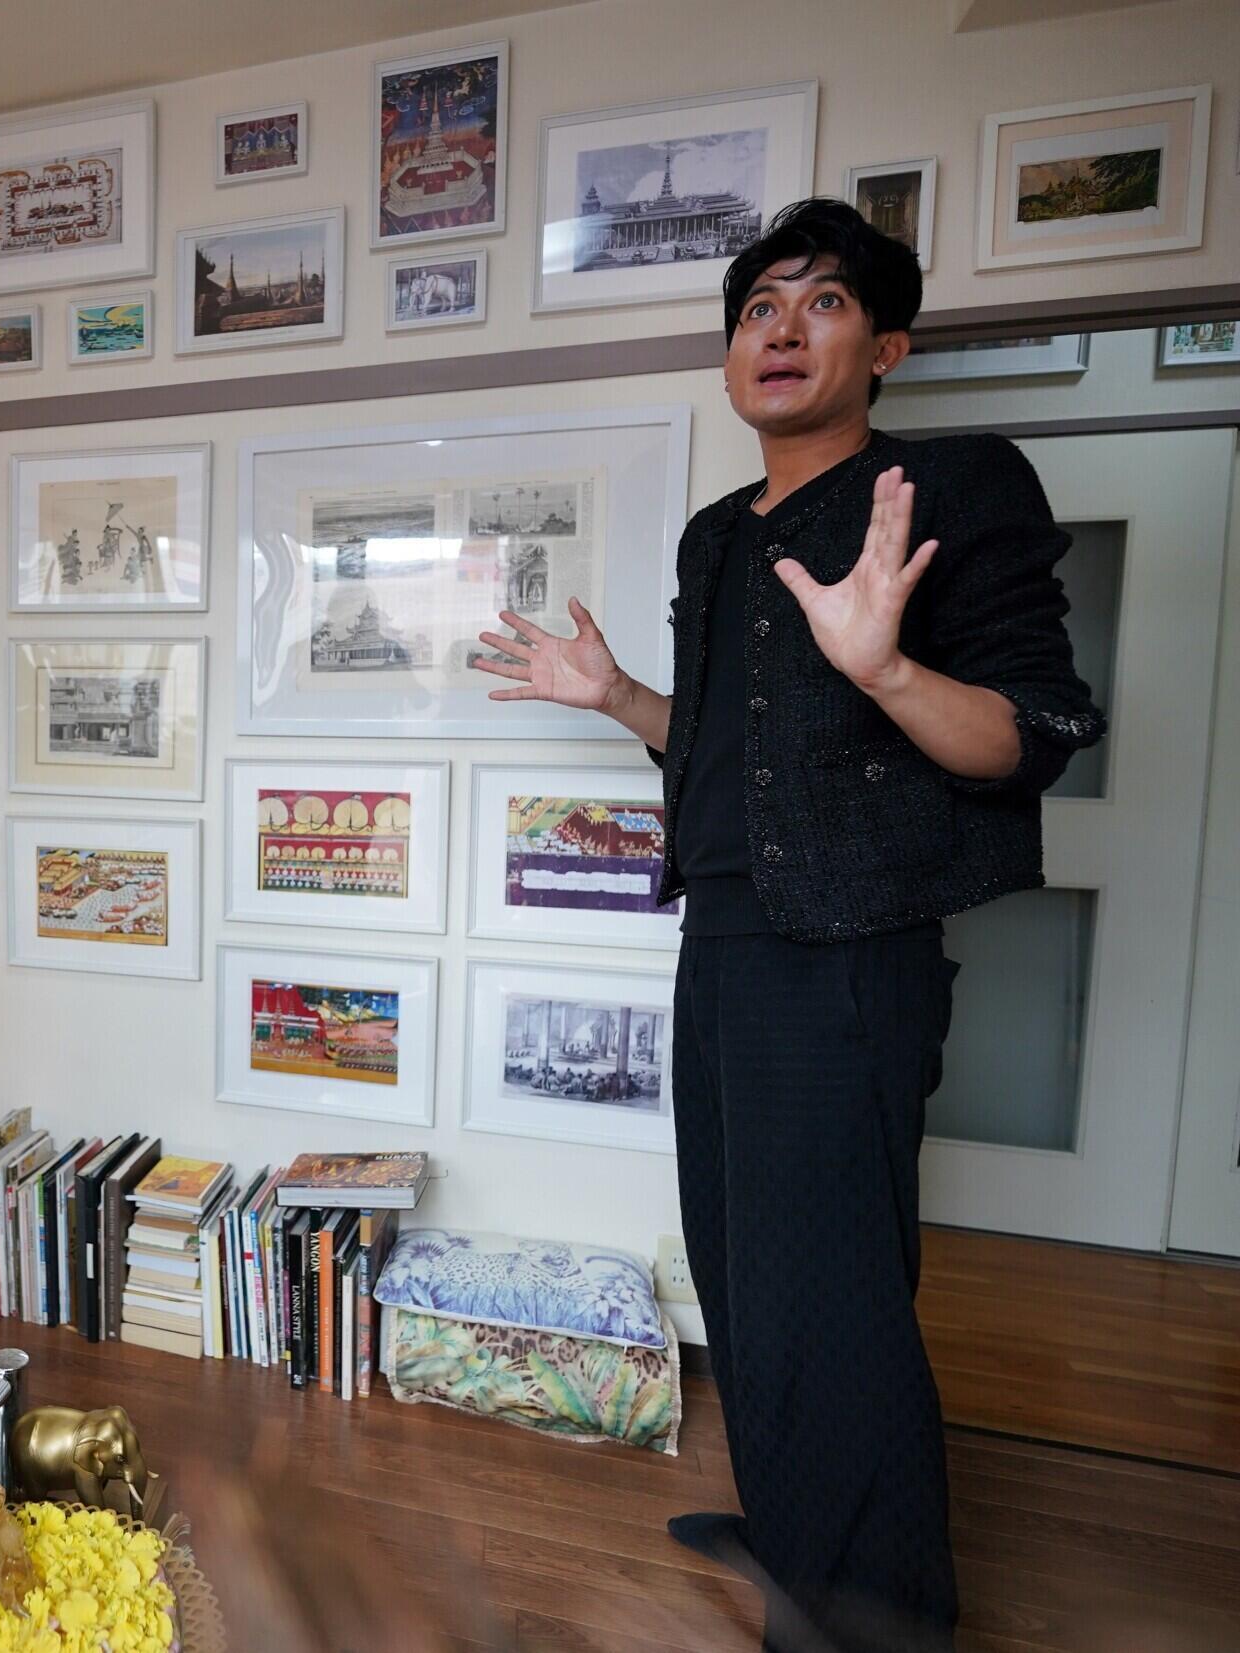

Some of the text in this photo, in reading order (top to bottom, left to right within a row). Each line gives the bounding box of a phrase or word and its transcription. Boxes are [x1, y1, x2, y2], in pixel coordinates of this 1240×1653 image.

[375, 1153, 422, 1161] BURMA
[310, 1231, 321, 1273] YANGON
[291, 1285, 301, 1341] LANNA STYLE
